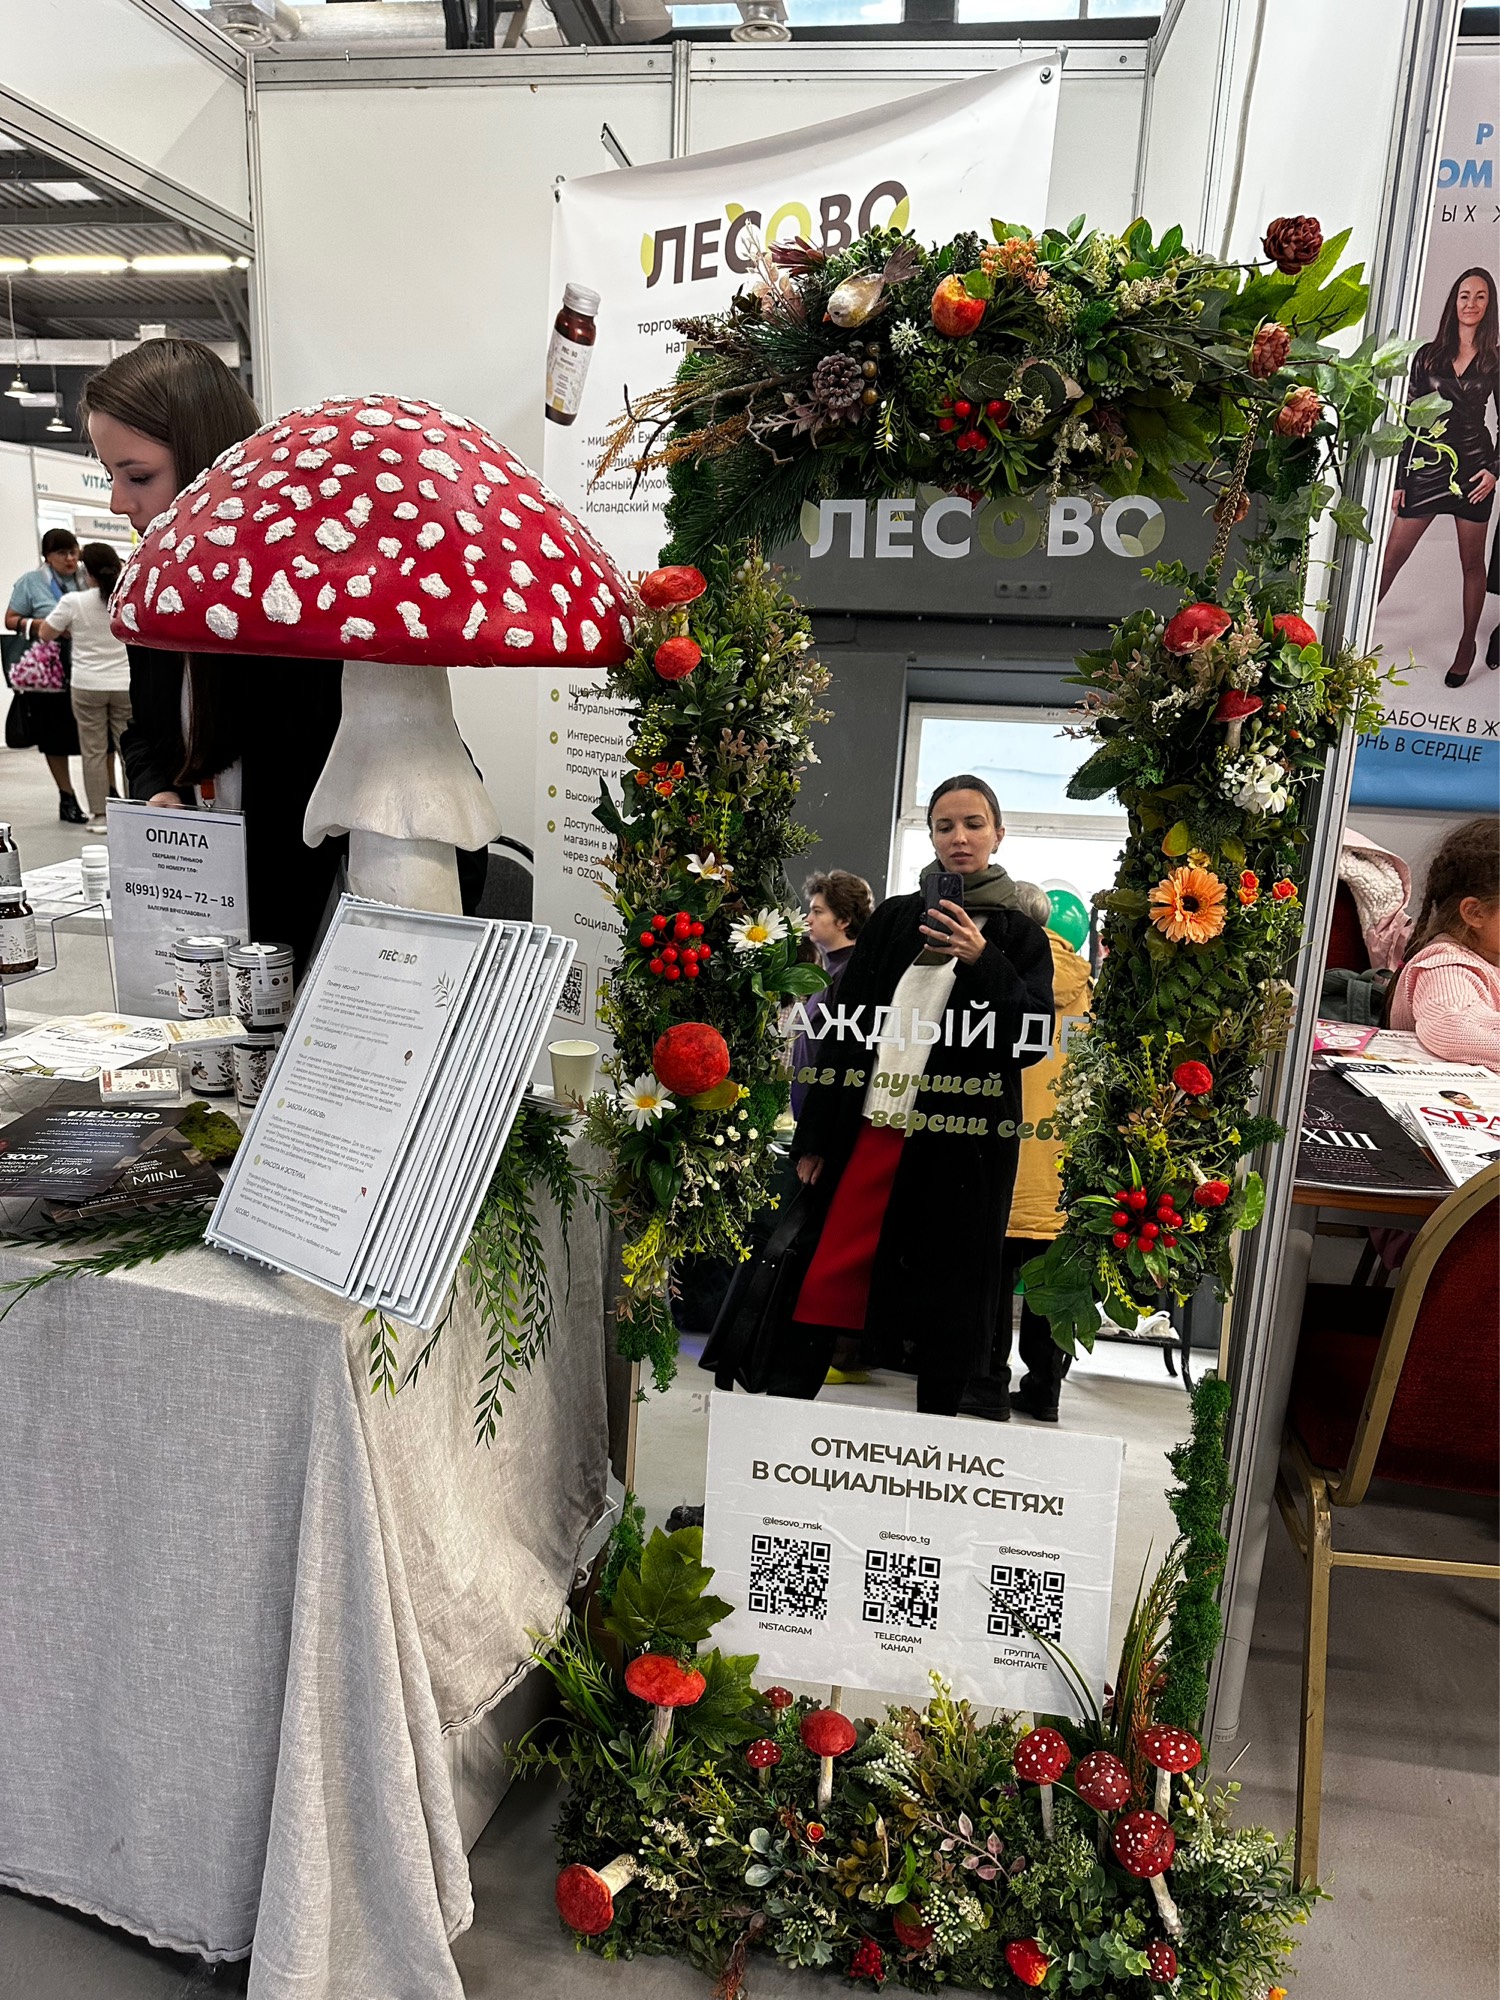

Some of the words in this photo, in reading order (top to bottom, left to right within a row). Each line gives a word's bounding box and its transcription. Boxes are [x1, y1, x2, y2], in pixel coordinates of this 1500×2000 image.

[644, 180, 909, 289] ЛЕСОВО
[586, 500, 649, 514] Исландский
[801, 495, 1166, 559] ЛЕСОВО
[1466, 718, 1477, 734] В
[567, 729, 623, 746] Интересный
[566, 747, 583, 758] про
[1395, 737, 1405, 752] В
[1411, 739, 1483, 763] СЕРДЦЕ
[566, 763, 608, 778] продукты
[146, 828, 209, 849] ОПЛАТА
[563, 834, 599, 850] магазин
[563, 850, 588, 864] через
[562, 865, 573, 875] на
[577, 866, 603, 881] OZON
[125, 882, 160, 899] 8(991)
[162, 887, 182, 901] 924
[194, 891, 208, 905] 72
[221, 895, 235, 908] 18
[767, 1000, 996, 1051] АЖДЫЙ
[1012, 1012, 1103, 1061] ДЕ
[1395, 1068, 1488, 1080] professional
[843, 1068, 866, 1088] к
[873, 1071, 1003, 1098] лучшей
[870, 1110, 988, 1138] версии
[811, 1436, 941, 1470] ОТМЕЧАЙ
[948, 1452, 1006, 1478] НАС
[752, 1460, 769, 1480] В
[773, 1463, 968, 1505] СОЦИАЛЬНЫХ
[972, 1487, 1065, 1517] СЕТЯХ!
[762, 1516, 823, 1531] @lesovo_msk
[879, 1531, 931, 1546] @lesovo_tg
[998, 1545, 1061, 1561] @lesovoshop
[758, 1621, 813, 1636] INSTAGRAM
[874, 1631, 923, 1645] TELEGRAM
[880, 1643, 914, 1654] КАНАЛ
[1003, 1648, 1041, 1660] ГРУППА
[993, 1656, 1048, 1671] ВКОНТАКТЕ
